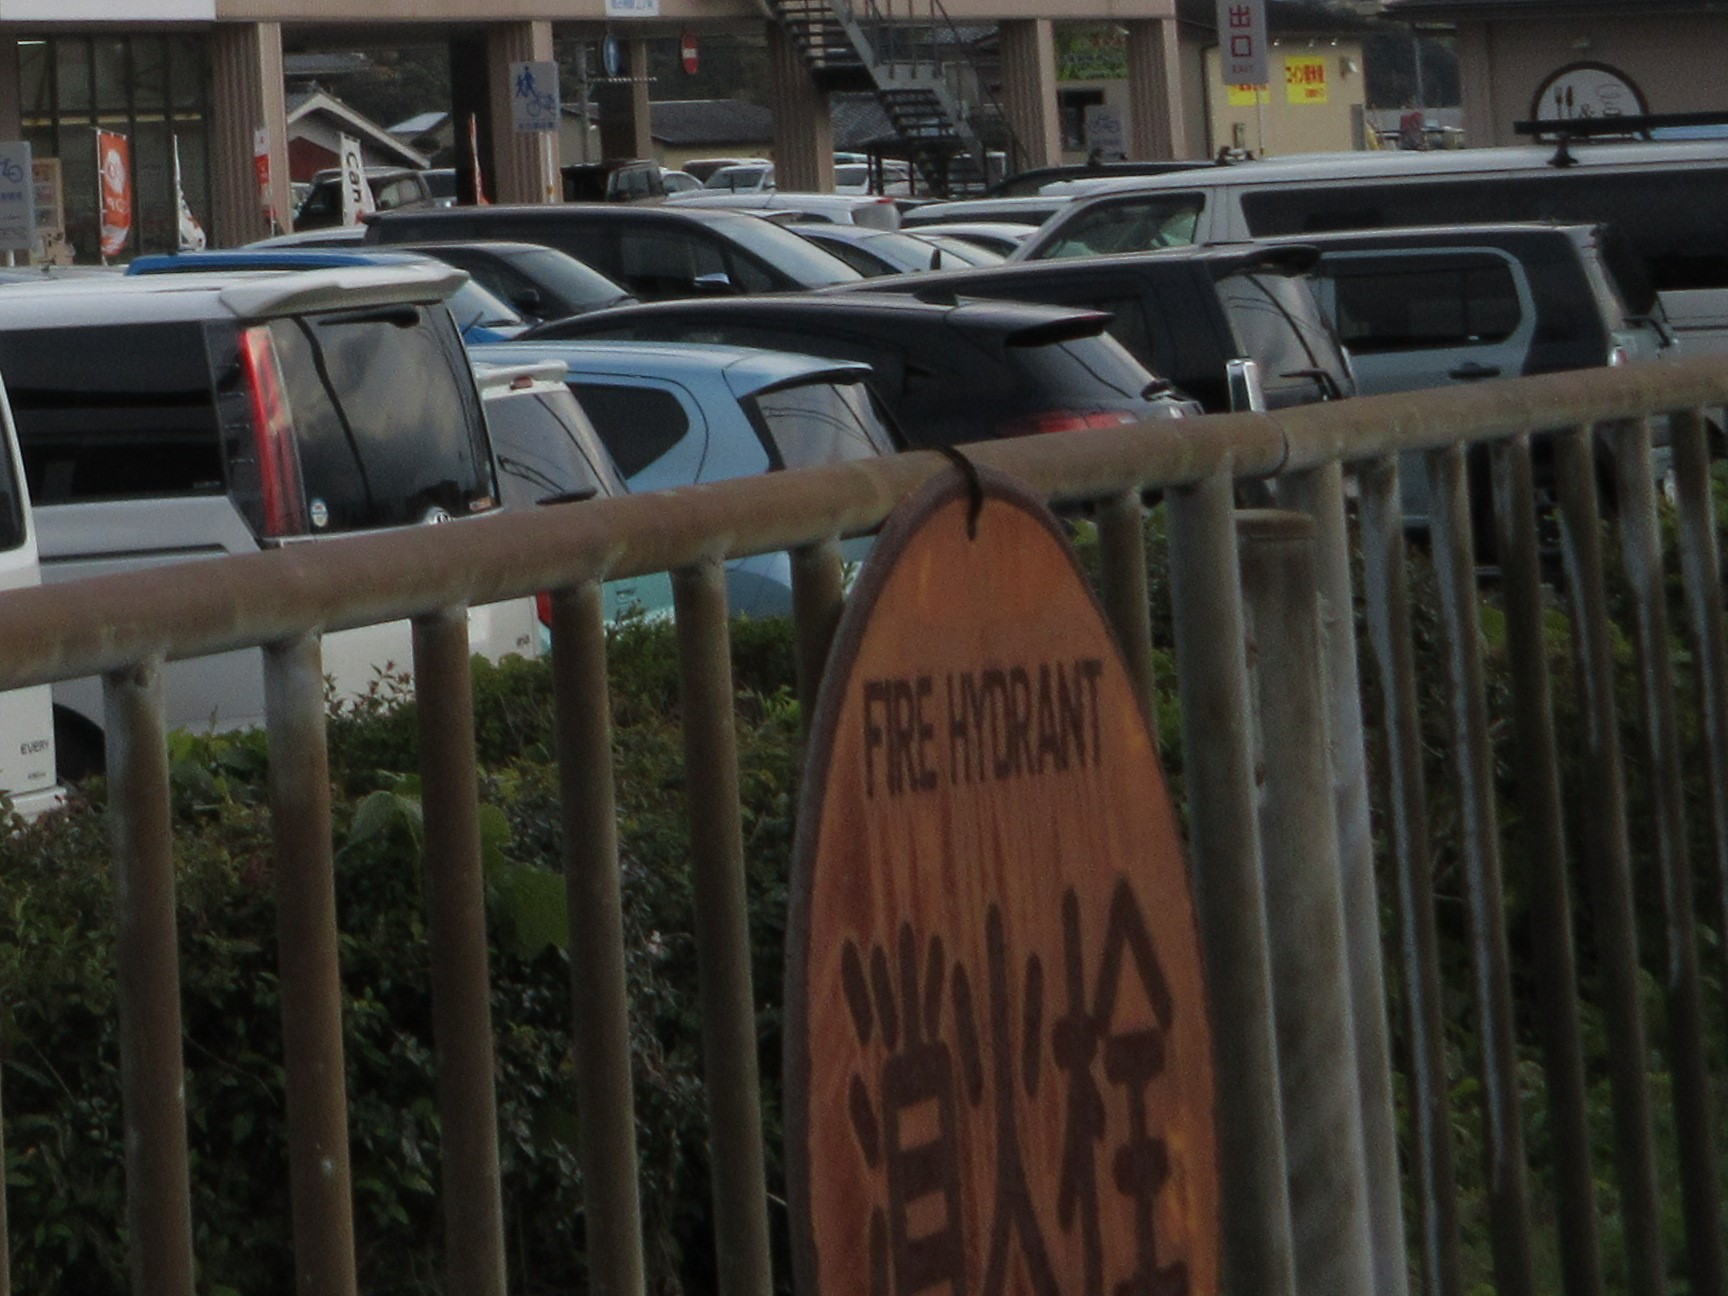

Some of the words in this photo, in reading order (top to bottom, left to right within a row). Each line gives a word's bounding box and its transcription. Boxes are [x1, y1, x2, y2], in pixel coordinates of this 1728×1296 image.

[1228, 3, 1252, 58] 出口
[861, 673, 937, 799] FIRE
[947, 658, 1104, 787] HYDRANT
